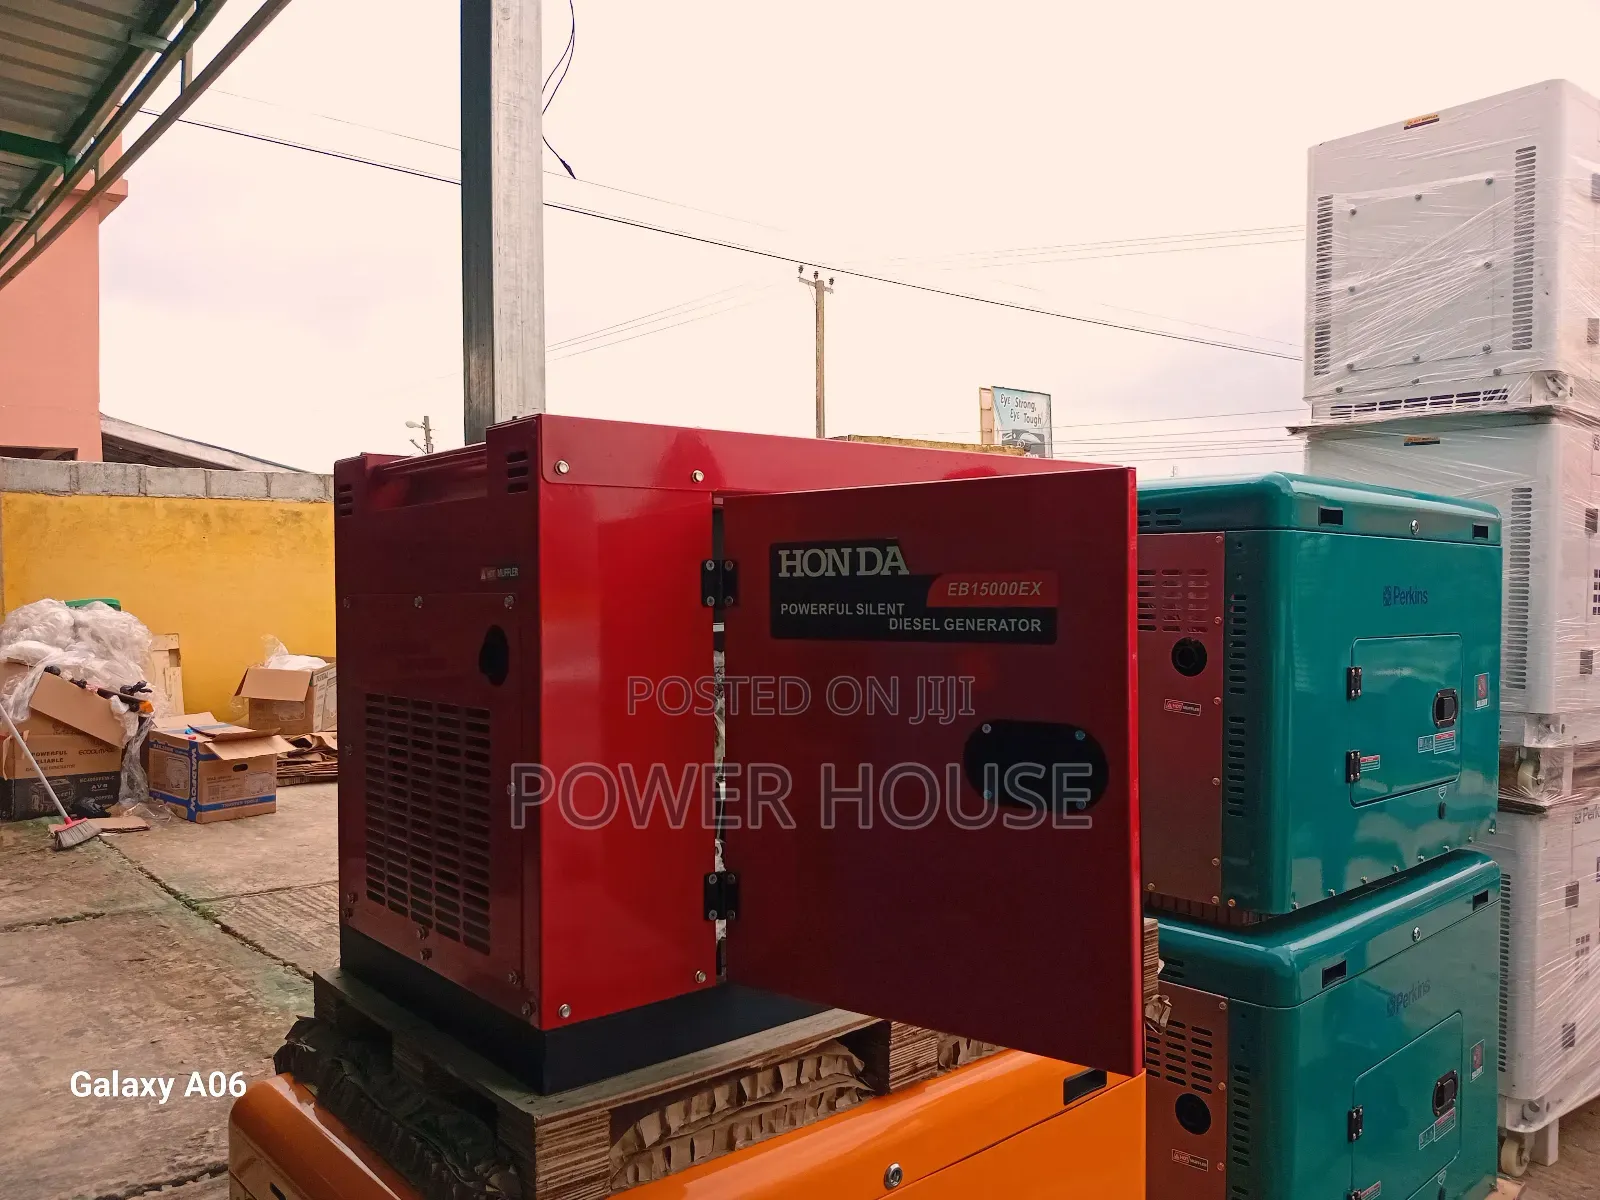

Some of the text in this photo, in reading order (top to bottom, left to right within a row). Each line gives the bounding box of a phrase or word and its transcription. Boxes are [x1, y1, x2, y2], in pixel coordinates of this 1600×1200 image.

[1023, 413, 1041, 427] Tough
[778, 546, 909, 577] HONDA
[947, 581, 1043, 596] EB15000EX
[1393, 585, 1429, 606] Perkins
[780, 602, 905, 616] POWERFUL SILENT
[889, 618, 1042, 632] DIESEL GENERATOR
[1395, 979, 1431, 1016] Perkins
